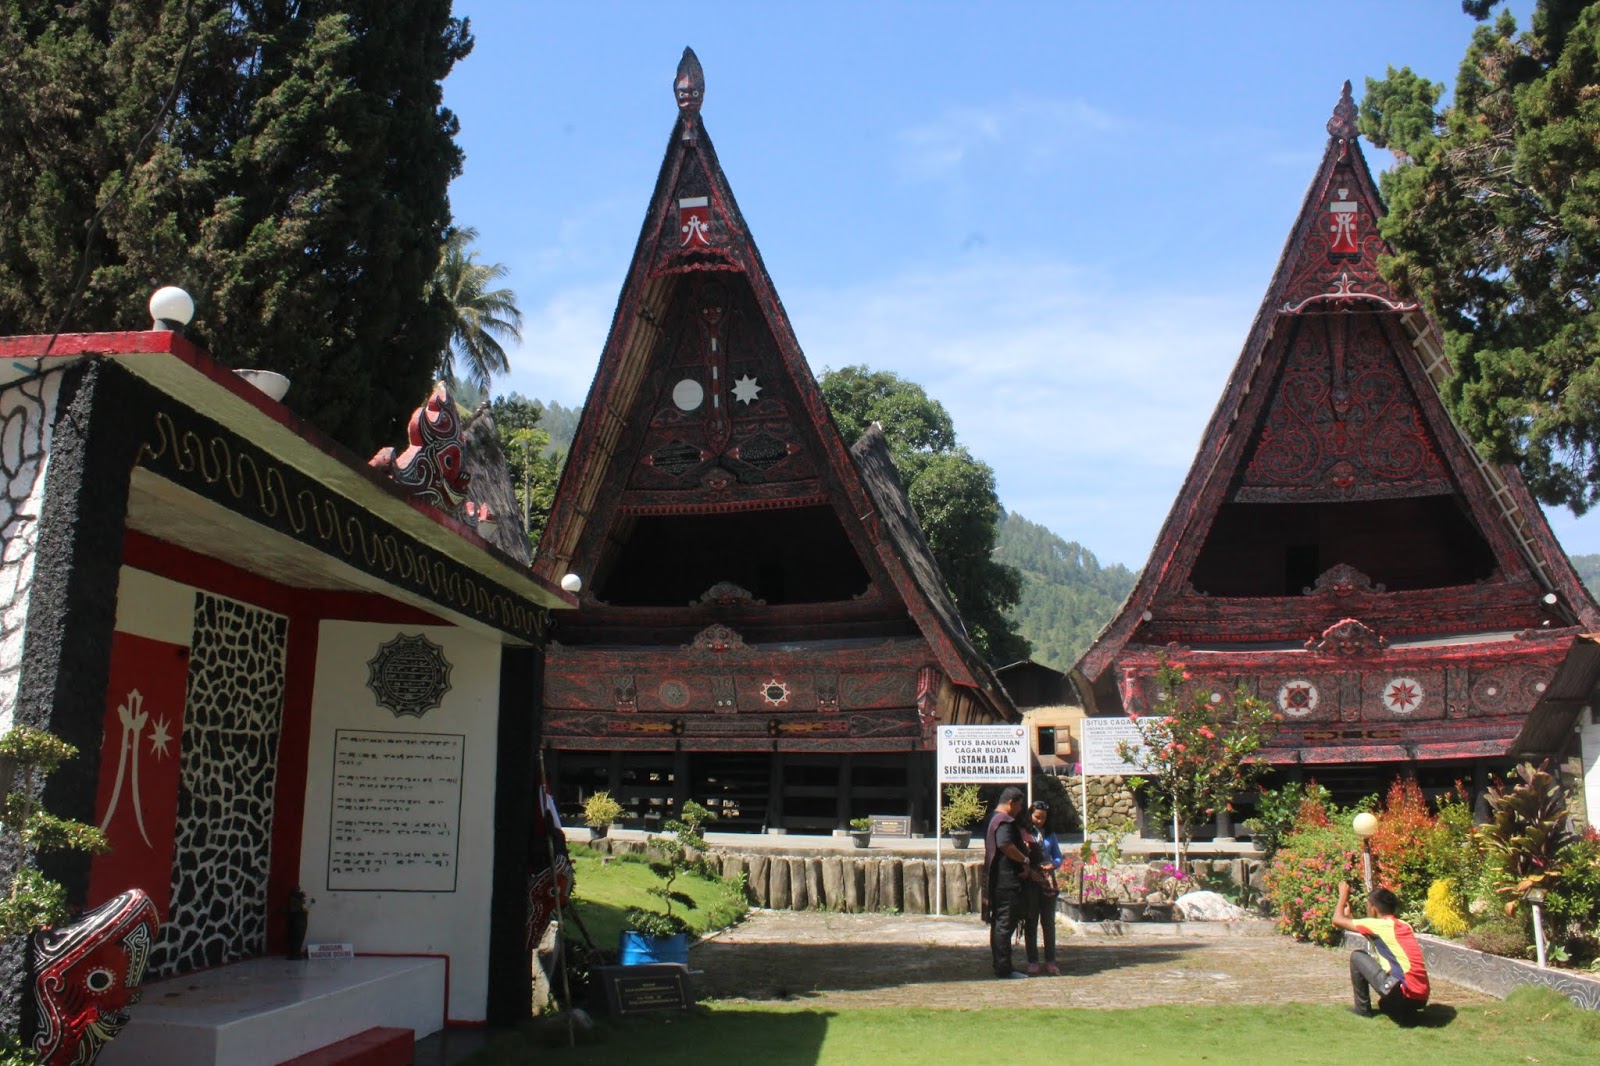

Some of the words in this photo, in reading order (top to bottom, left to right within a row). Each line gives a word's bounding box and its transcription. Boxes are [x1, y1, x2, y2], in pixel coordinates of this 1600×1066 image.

[958, 755, 986, 763] ISTANA
[989, 755, 1008, 763] RAJA
[944, 766, 1025, 774] SISINGAMANGARAJA
